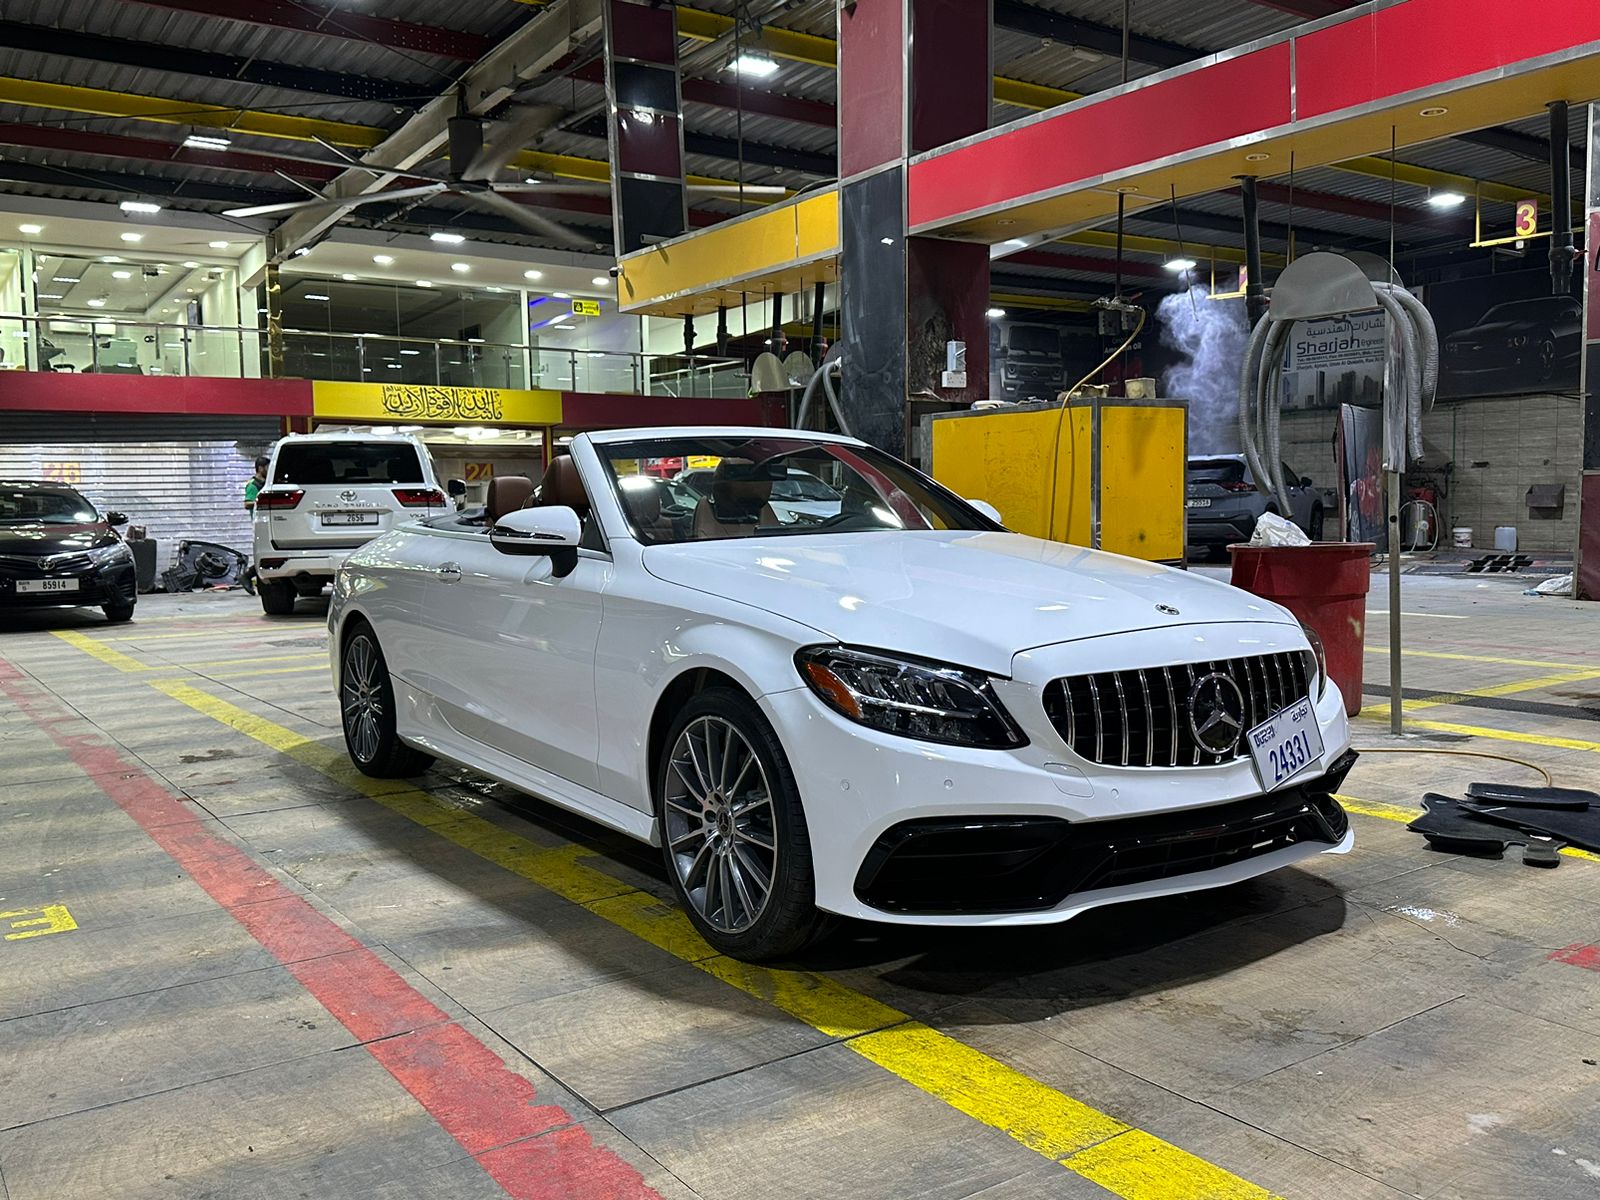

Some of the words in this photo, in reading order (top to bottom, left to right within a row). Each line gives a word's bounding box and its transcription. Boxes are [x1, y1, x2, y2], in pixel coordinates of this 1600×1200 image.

[1516, 203, 1536, 236] 3
[1296, 337, 1360, 355] Sharjah
[466, 464, 492, 480] 24
[346, 513, 365, 522] 2656
[42, 580, 66, 590] 85914
[1291, 704, 1308, 722] تجارية
[1269, 730, 1311, 781] 24331
